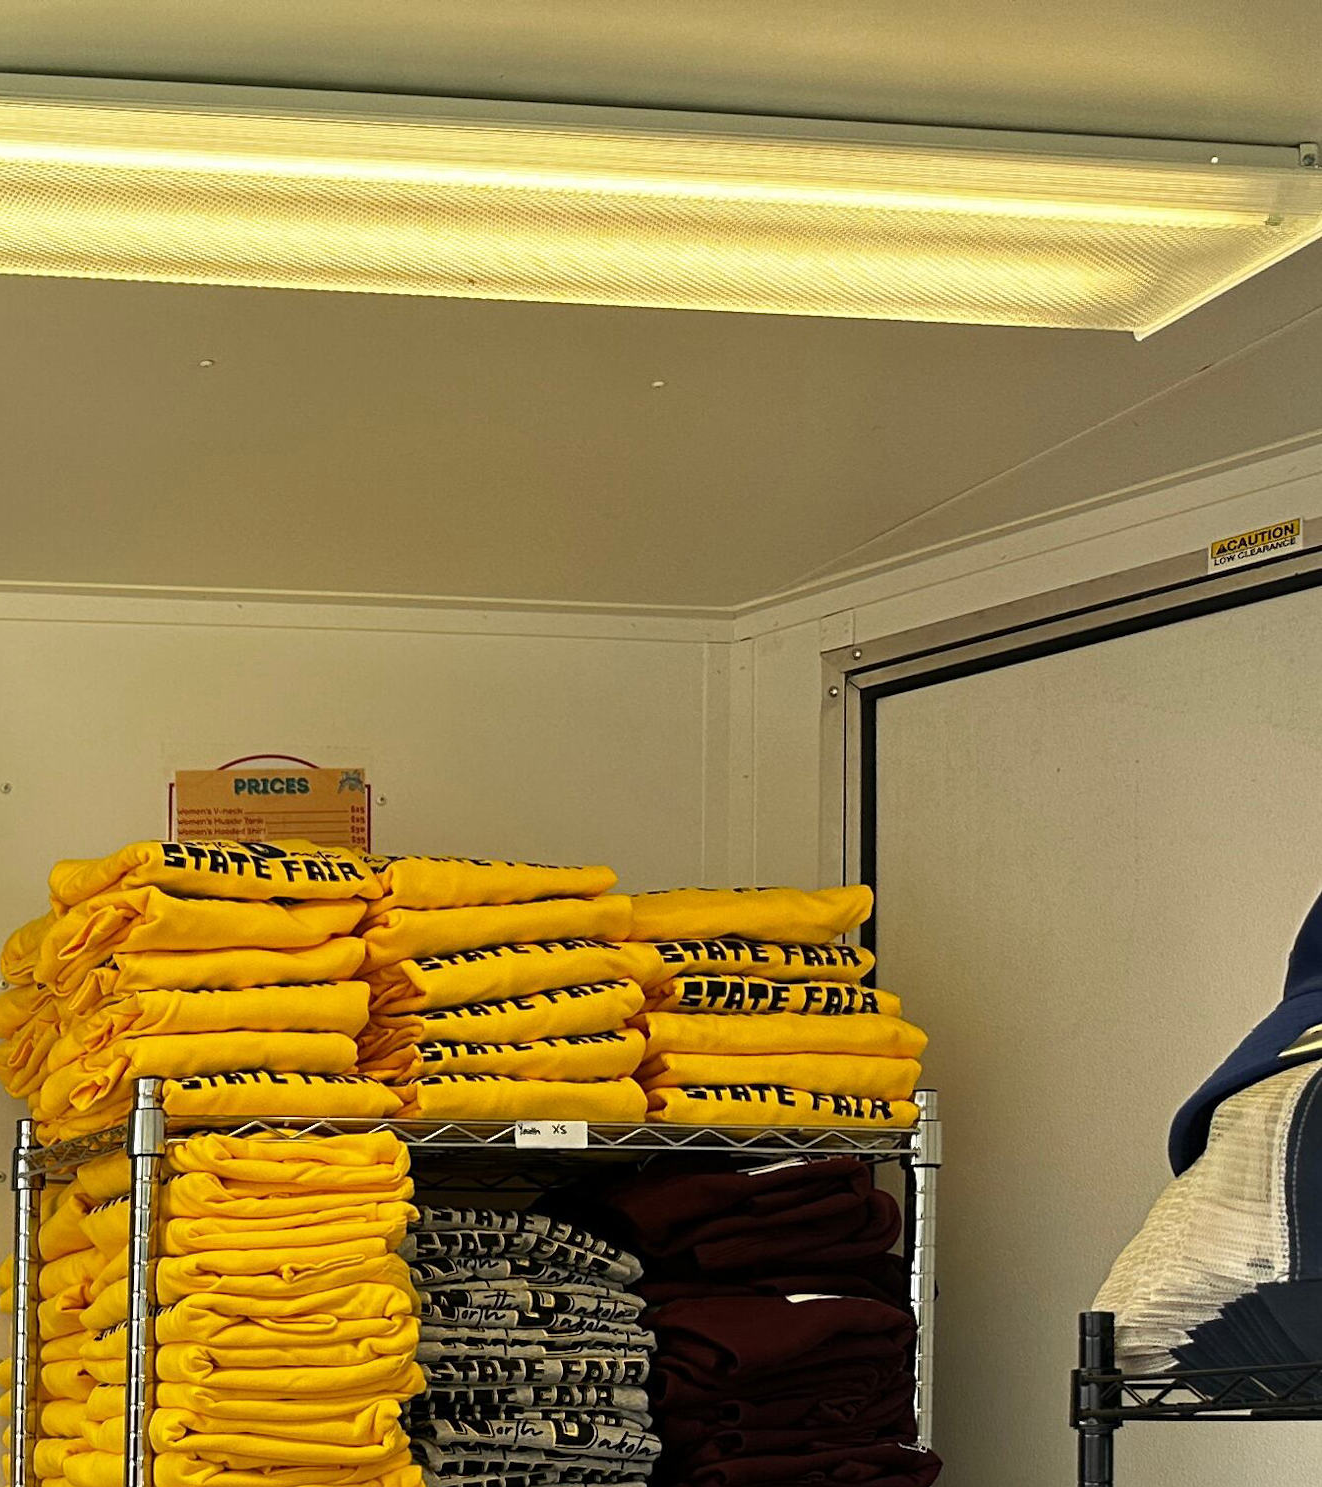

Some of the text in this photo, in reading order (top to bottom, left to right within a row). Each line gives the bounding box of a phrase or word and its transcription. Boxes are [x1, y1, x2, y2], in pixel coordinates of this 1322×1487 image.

[1213, 536, 1297, 567] LOW CLEARANCE
[1226, 522, 1295, 552] CAUTION
[233, 777, 310, 796] PRICES
[161, 842, 272, 880] STATE
[280, 859, 365, 883] FAIR
[654, 938, 862, 968] STATE FAIR
[678, 980, 881, 1016] STATE FAIR
[681, 1084, 895, 1121] STATE FAIR
[551, 1123, 567, 1135] XS
[427, 1358, 645, 1385] STATE FAIR
